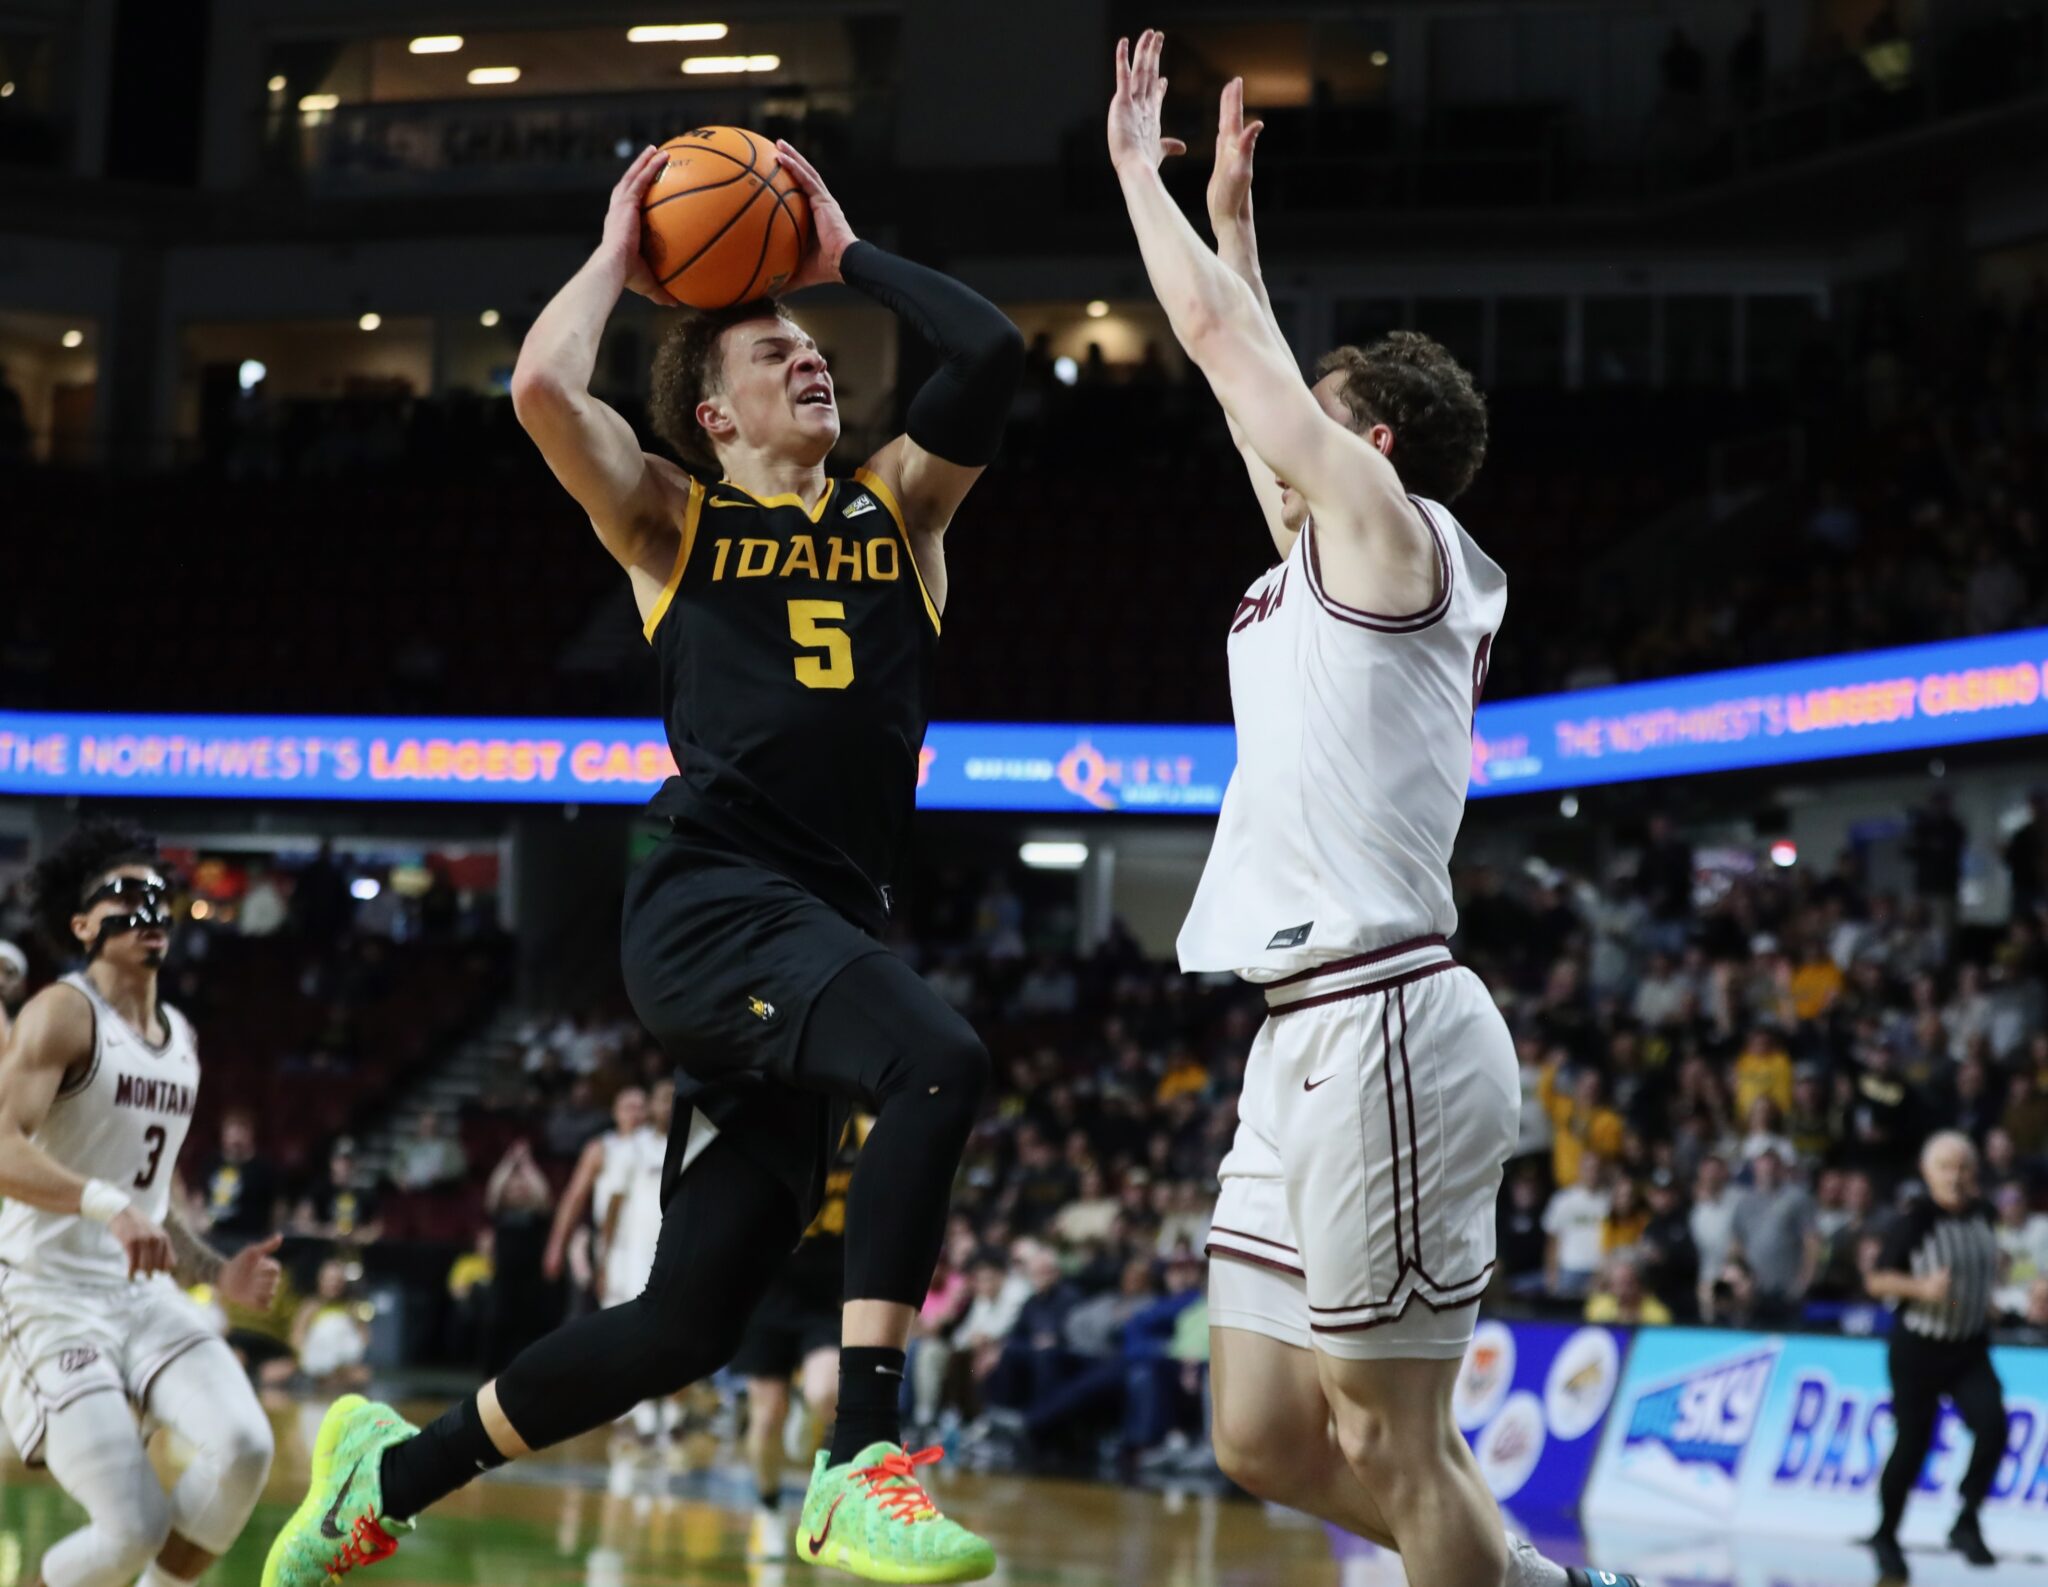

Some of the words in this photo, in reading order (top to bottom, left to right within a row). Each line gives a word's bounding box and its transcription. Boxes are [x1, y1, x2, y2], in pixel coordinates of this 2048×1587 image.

[712, 535, 899, 581] IDAHO
[787, 600, 854, 689] 5
[1786, 677, 1916, 733] LARGEST
[79, 734, 361, 780] NORTHWEST'S
[369, 739, 564, 782] LARGEST
[114, 1072, 196, 1116] MONTAN
[133, 1124, 166, 1191] 3
